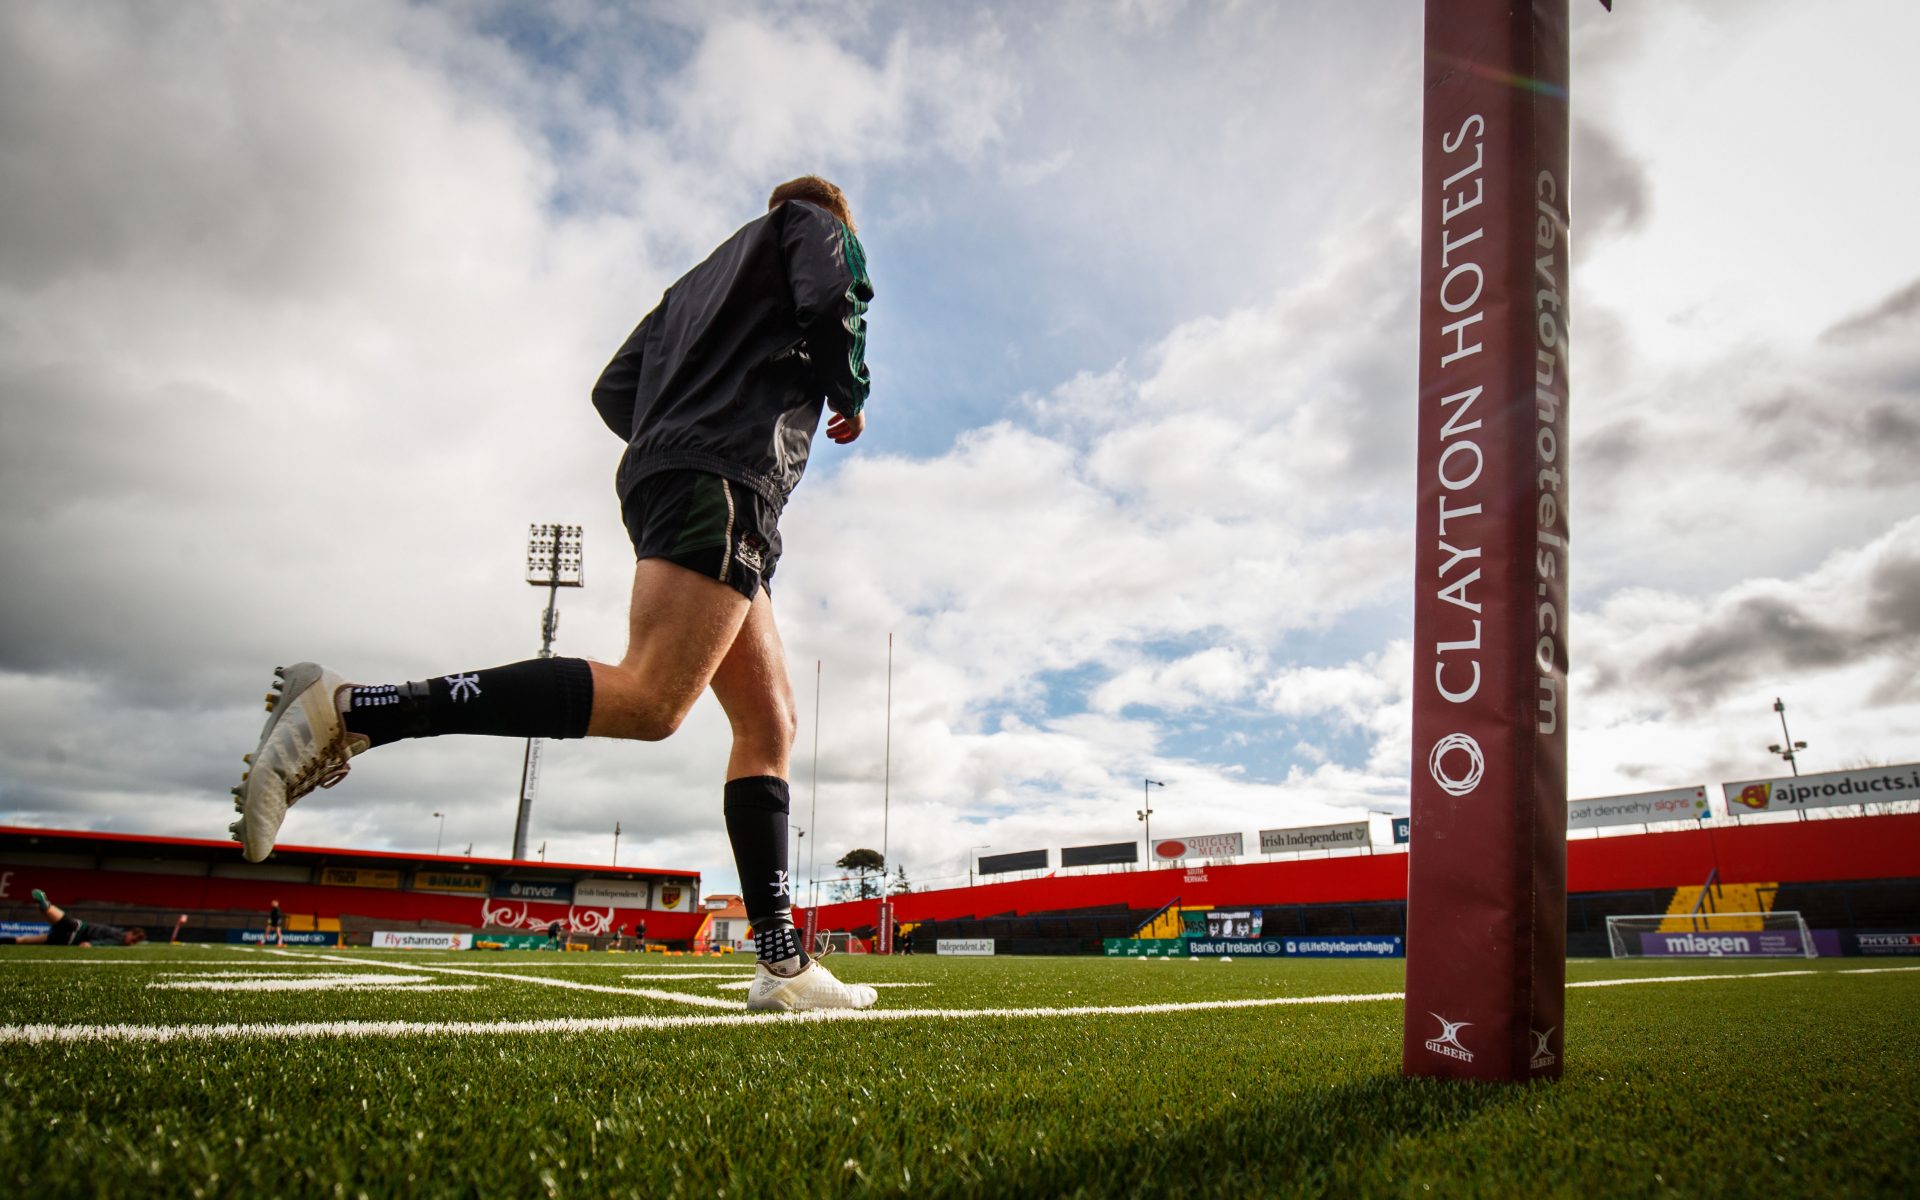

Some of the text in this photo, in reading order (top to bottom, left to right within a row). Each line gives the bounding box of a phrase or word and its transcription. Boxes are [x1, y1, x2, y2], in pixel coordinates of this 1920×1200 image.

[1435, 114, 1485, 703] CLAYTON HOTELS
[1535, 170, 1562, 734] claytonhotels.com
[1570, 799, 1689, 820] pat dennehy signs
[1188, 836, 1237, 849] QUIGLEY
[1261, 829, 1353, 848] Irish Independent
[1198, 845, 1235, 856] MEATS
[522, 885, 557, 897] inver
[278, 933, 309, 943] reland
[1190, 941, 1262, 953] Bank of Ireland
[1665, 934, 1750, 957] miagen
[1425, 1040, 1474, 1063] GILBERT
